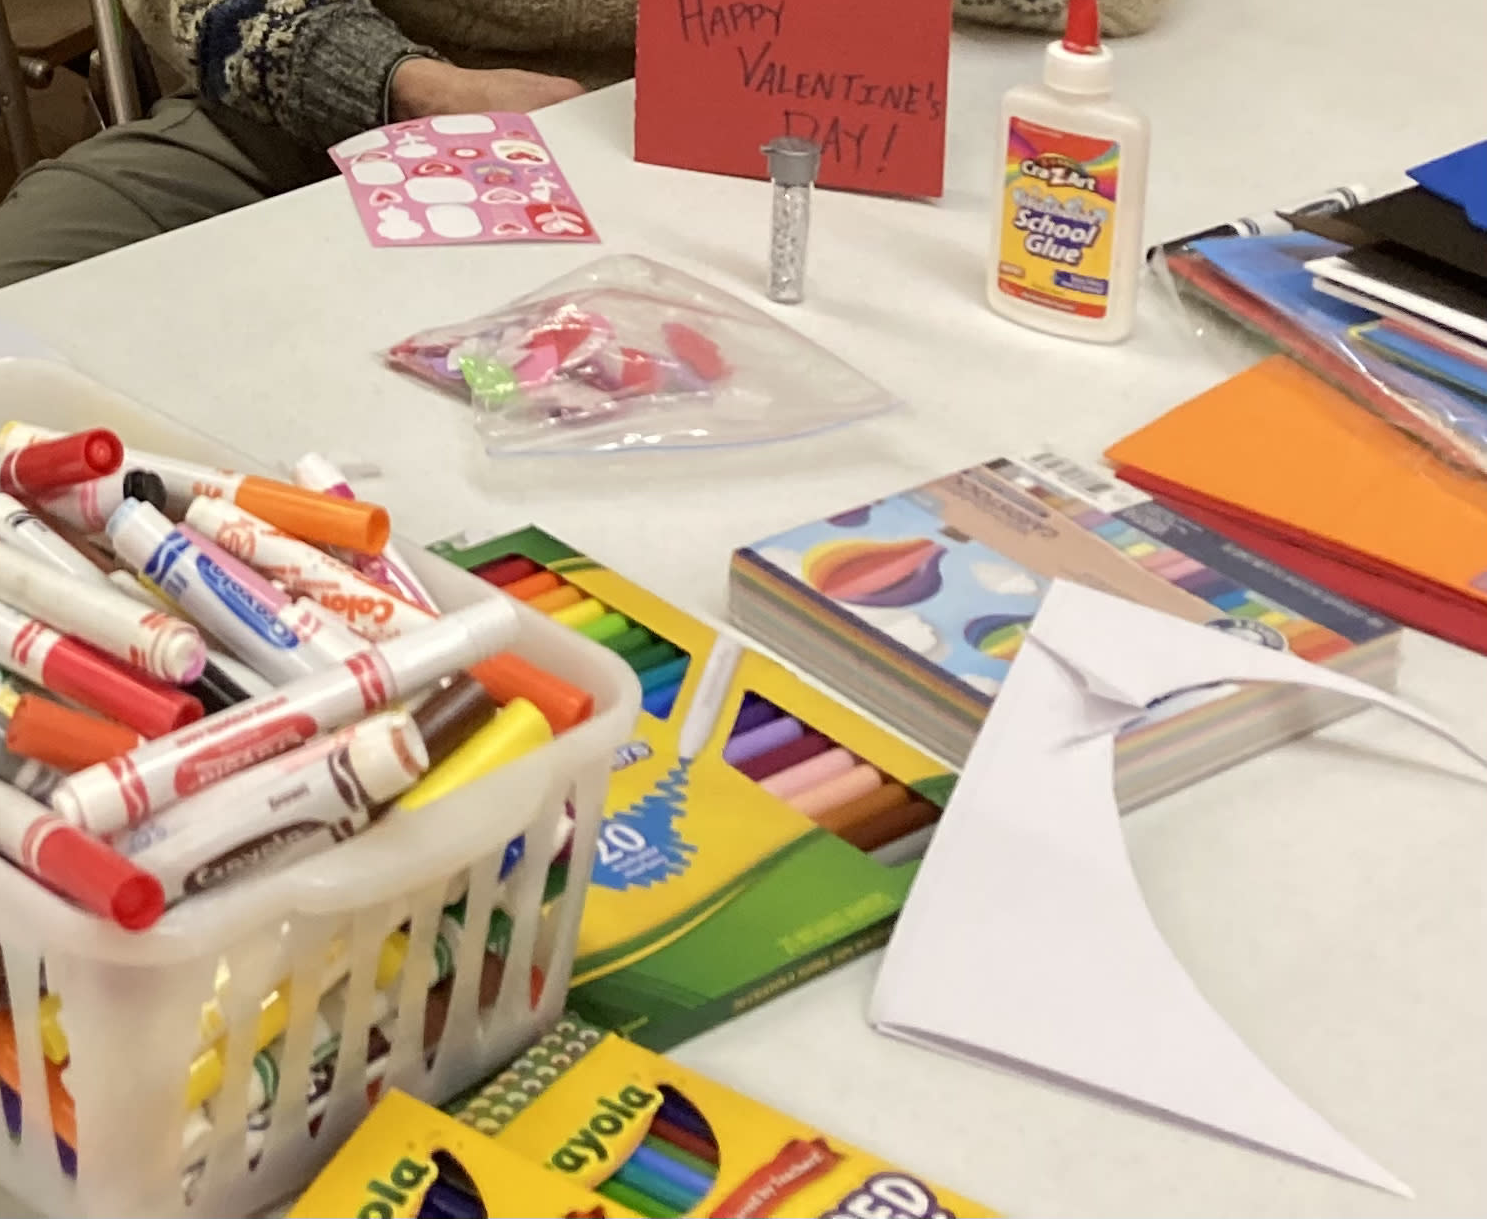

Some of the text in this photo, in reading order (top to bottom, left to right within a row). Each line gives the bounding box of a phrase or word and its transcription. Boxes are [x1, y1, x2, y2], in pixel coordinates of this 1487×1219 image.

[783, 109, 899, 173] DAY!
[1013, 208, 1099, 246] School
[1024, 233, 1081, 264] Glue
[320, 593, 395, 624] Color
[596, 823, 646, 866] 20
[545, 1084, 656, 1174] ayola
